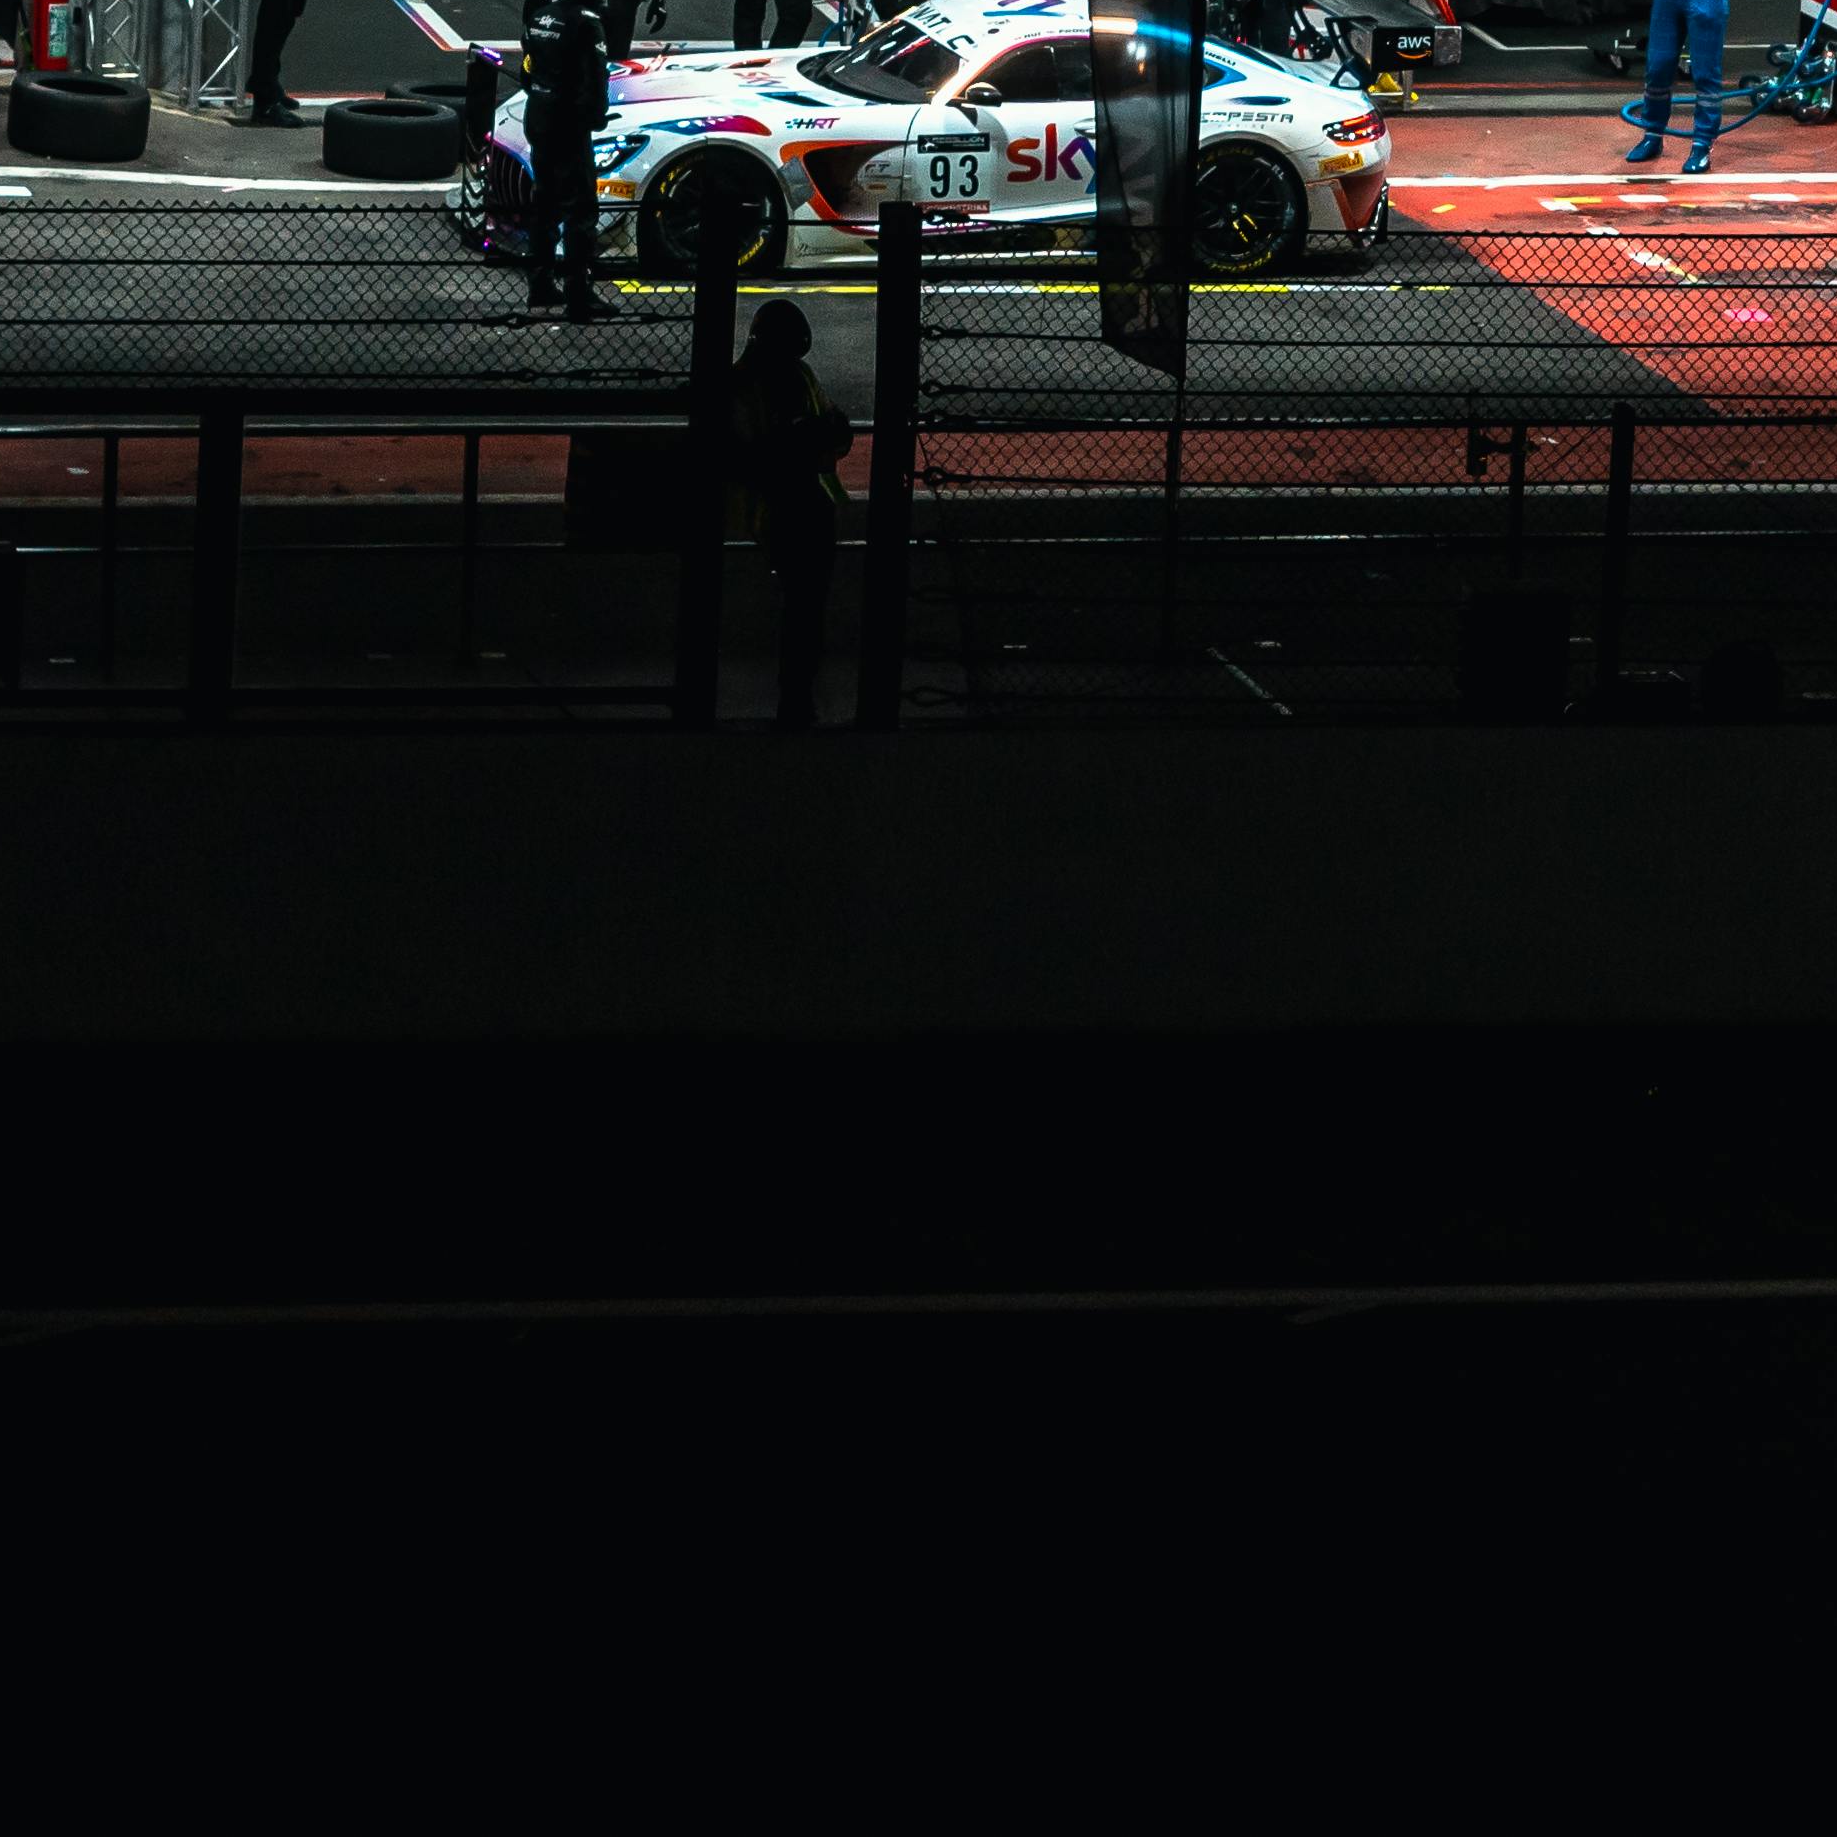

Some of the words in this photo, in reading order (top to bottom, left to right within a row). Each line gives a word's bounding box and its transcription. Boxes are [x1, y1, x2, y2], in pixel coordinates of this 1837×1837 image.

[1397, 35, 1431, 50] aws
[793, 117, 841, 130] HRT
[930, 155, 980, 198] 93
